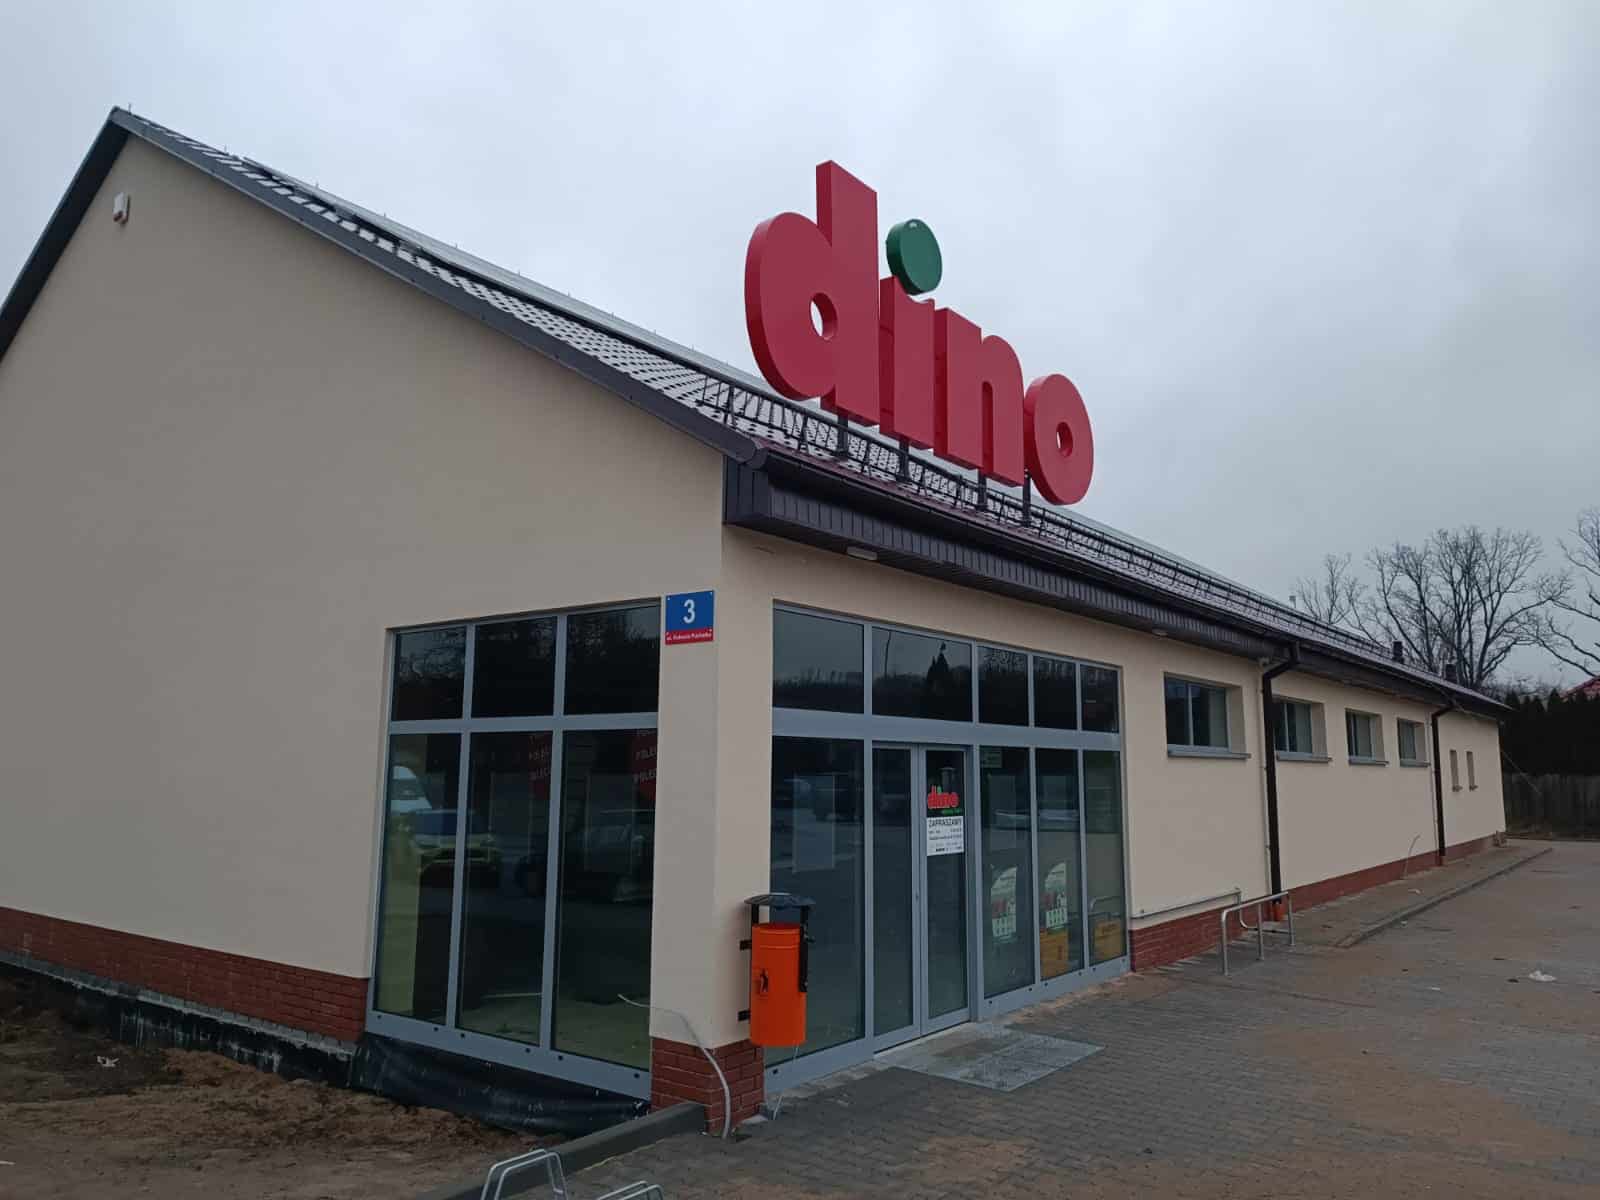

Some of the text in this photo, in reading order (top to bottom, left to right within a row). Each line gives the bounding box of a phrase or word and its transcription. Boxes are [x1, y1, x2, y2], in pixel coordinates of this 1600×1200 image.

[744, 160, 1094, 505] dino
[683, 599, 696, 624] 3
[927, 785, 959, 809] dino
